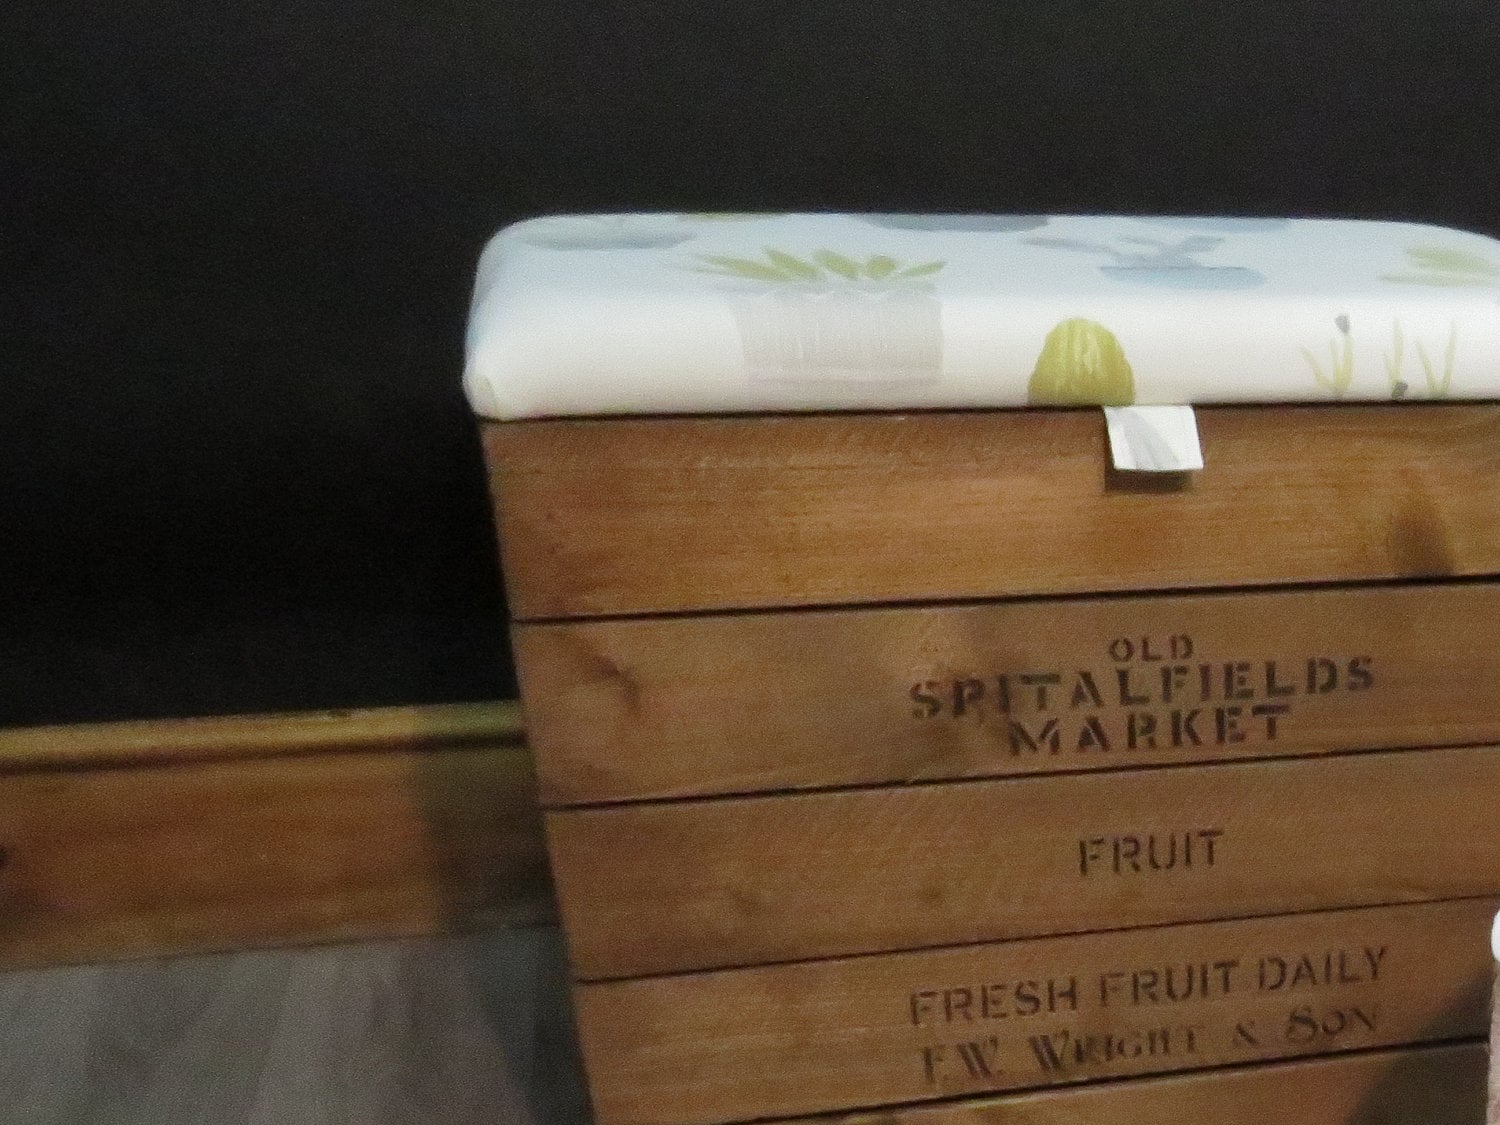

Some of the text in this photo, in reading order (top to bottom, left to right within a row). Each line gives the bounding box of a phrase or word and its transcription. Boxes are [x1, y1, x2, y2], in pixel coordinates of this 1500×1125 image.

[1109, 633, 1195, 663] OLD
[909, 655, 1376, 718] SPITALFIELDS
[1008, 704, 1291, 757] MARKET
[1078, 828, 1225, 877] FRUIT
[910, 945, 1390, 1027] FRESH FRUIT DAILY
